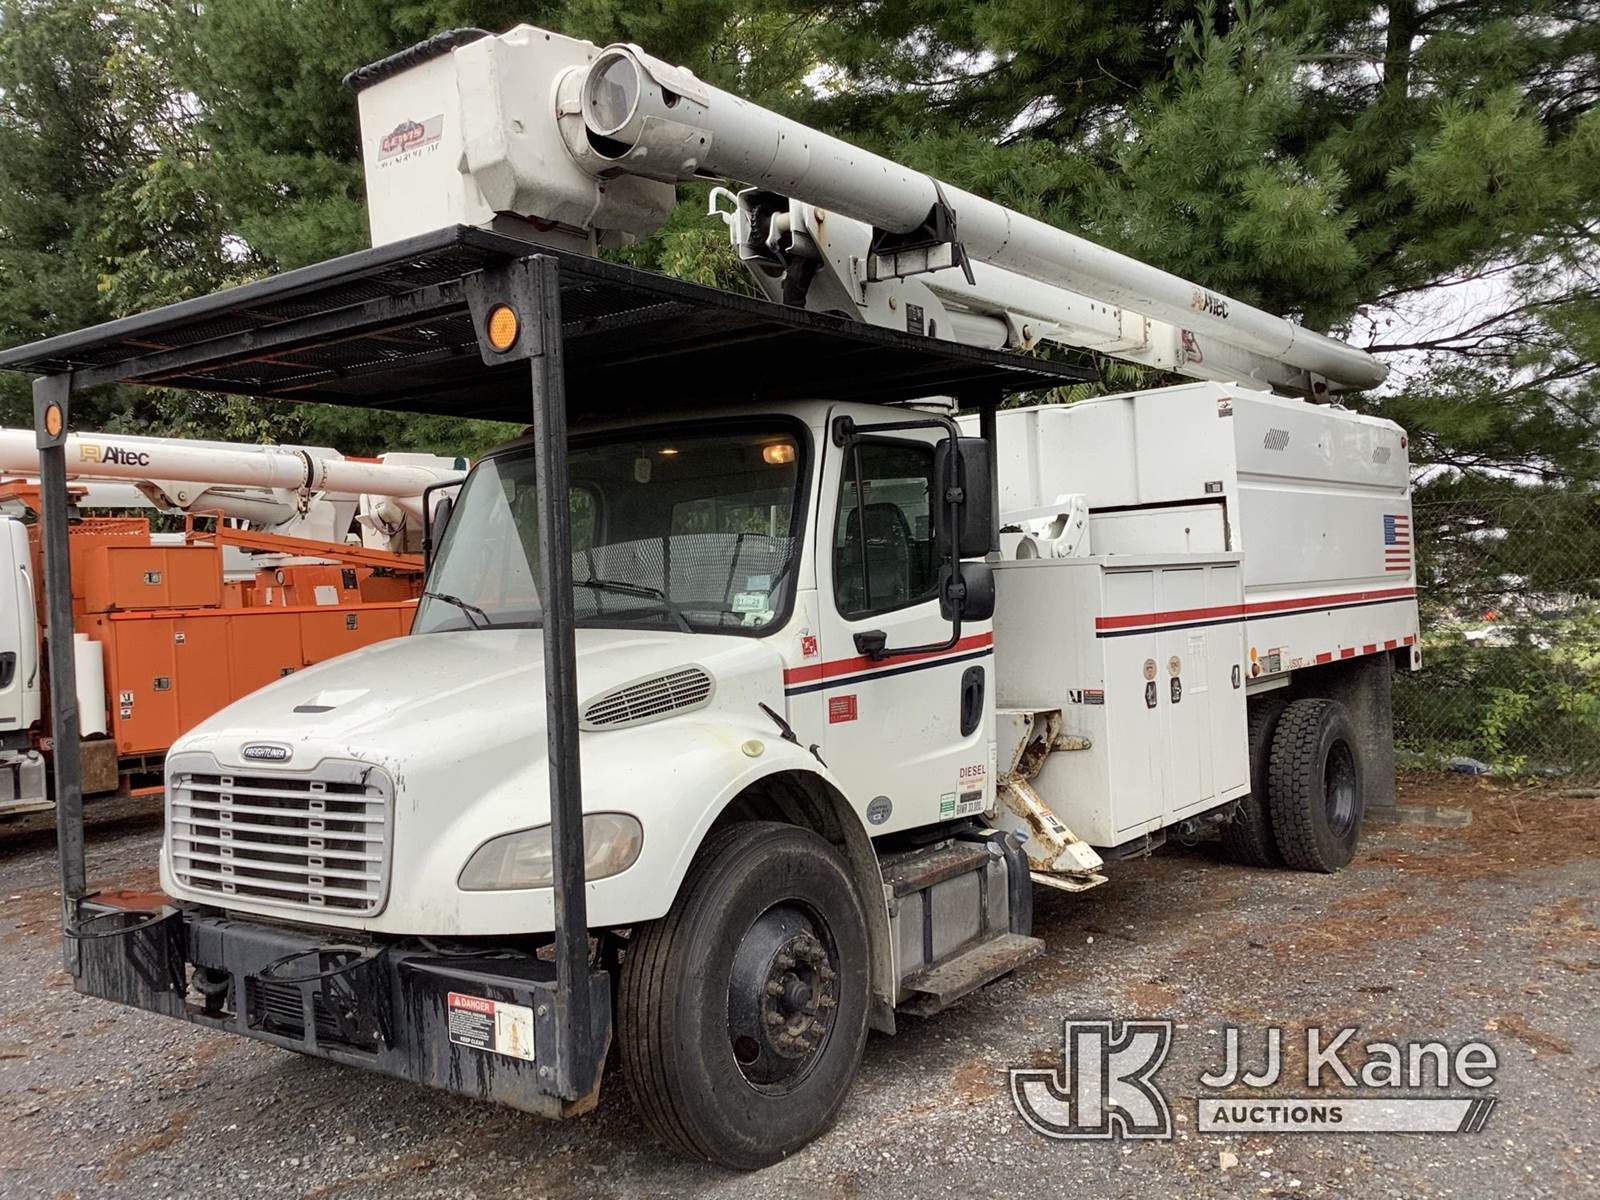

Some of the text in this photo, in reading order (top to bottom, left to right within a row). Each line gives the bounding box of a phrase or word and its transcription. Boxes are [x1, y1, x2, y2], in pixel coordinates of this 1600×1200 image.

[102, 446, 150, 466] Altec
[245, 748, 285, 758] FREIGHTLINER
[960, 765, 986, 778] DIESEL
[461, 998, 490, 1013] DANGER
